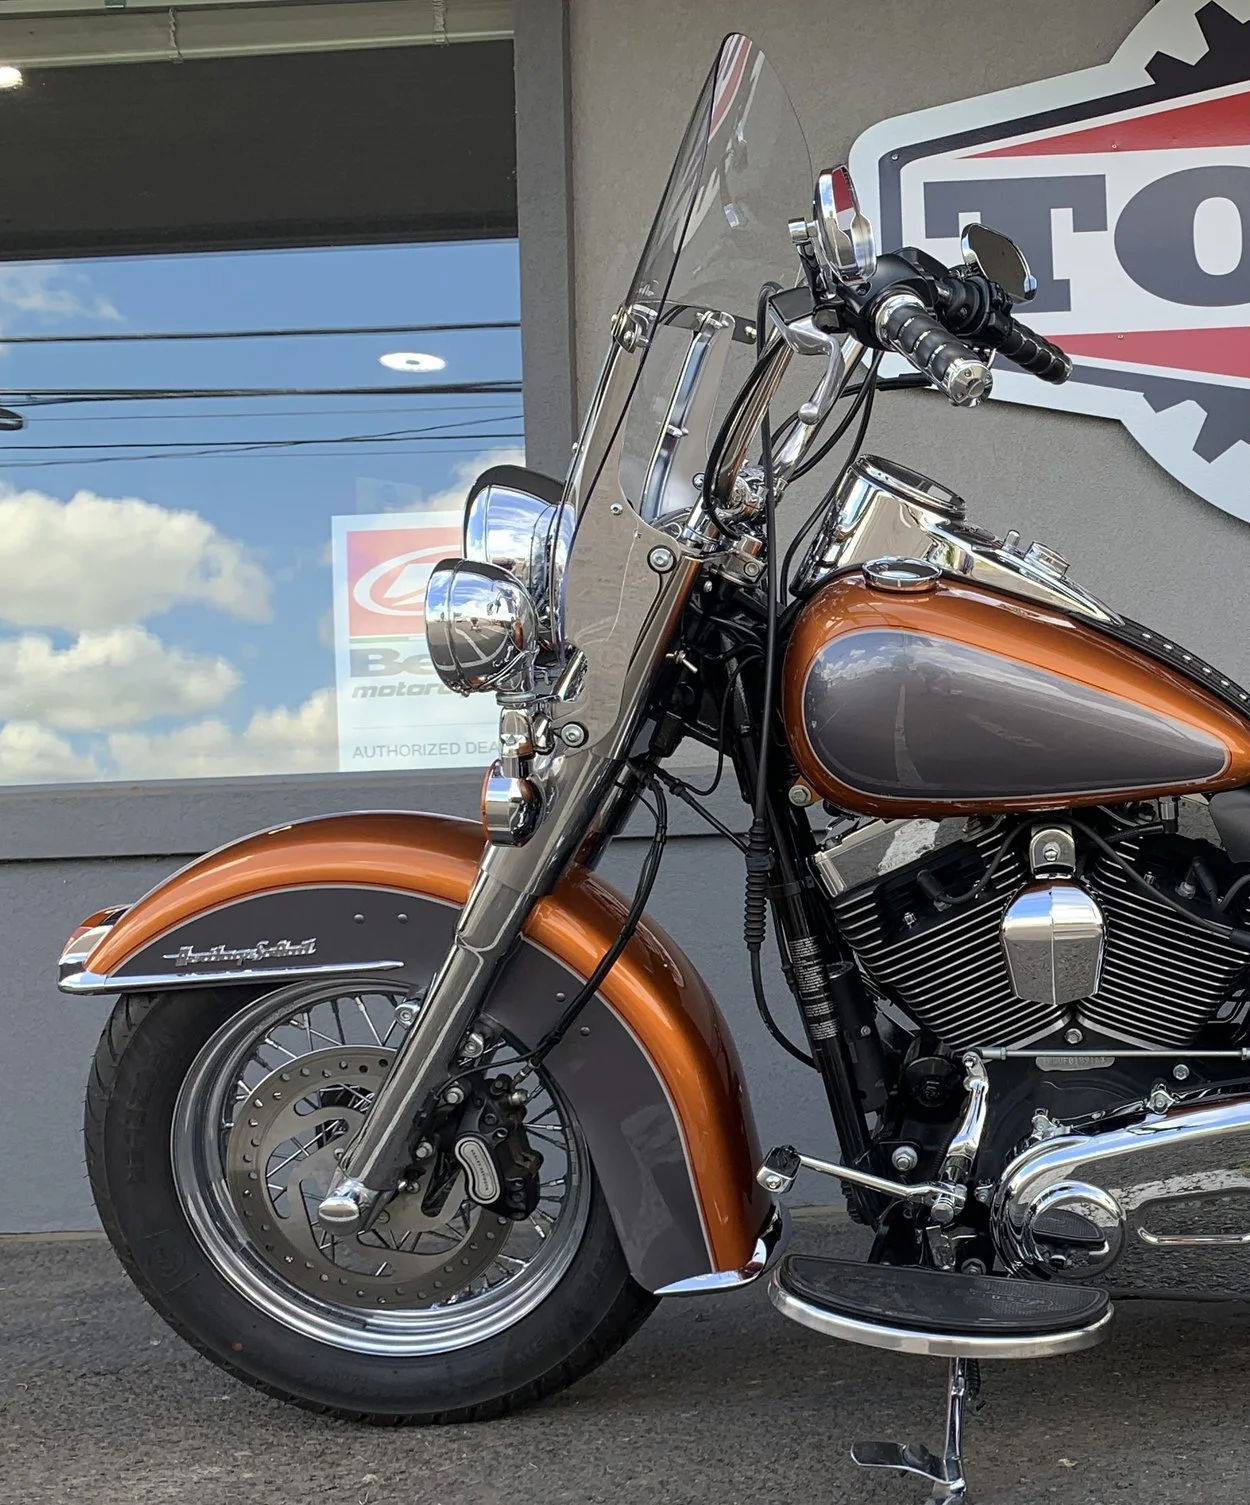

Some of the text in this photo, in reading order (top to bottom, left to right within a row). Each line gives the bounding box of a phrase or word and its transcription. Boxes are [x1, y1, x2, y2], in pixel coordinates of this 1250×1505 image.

[350, 648, 434, 678] Be
[352, 681, 453, 698] motorc
[352, 741, 499, 759] AUTHORIZED DEA
